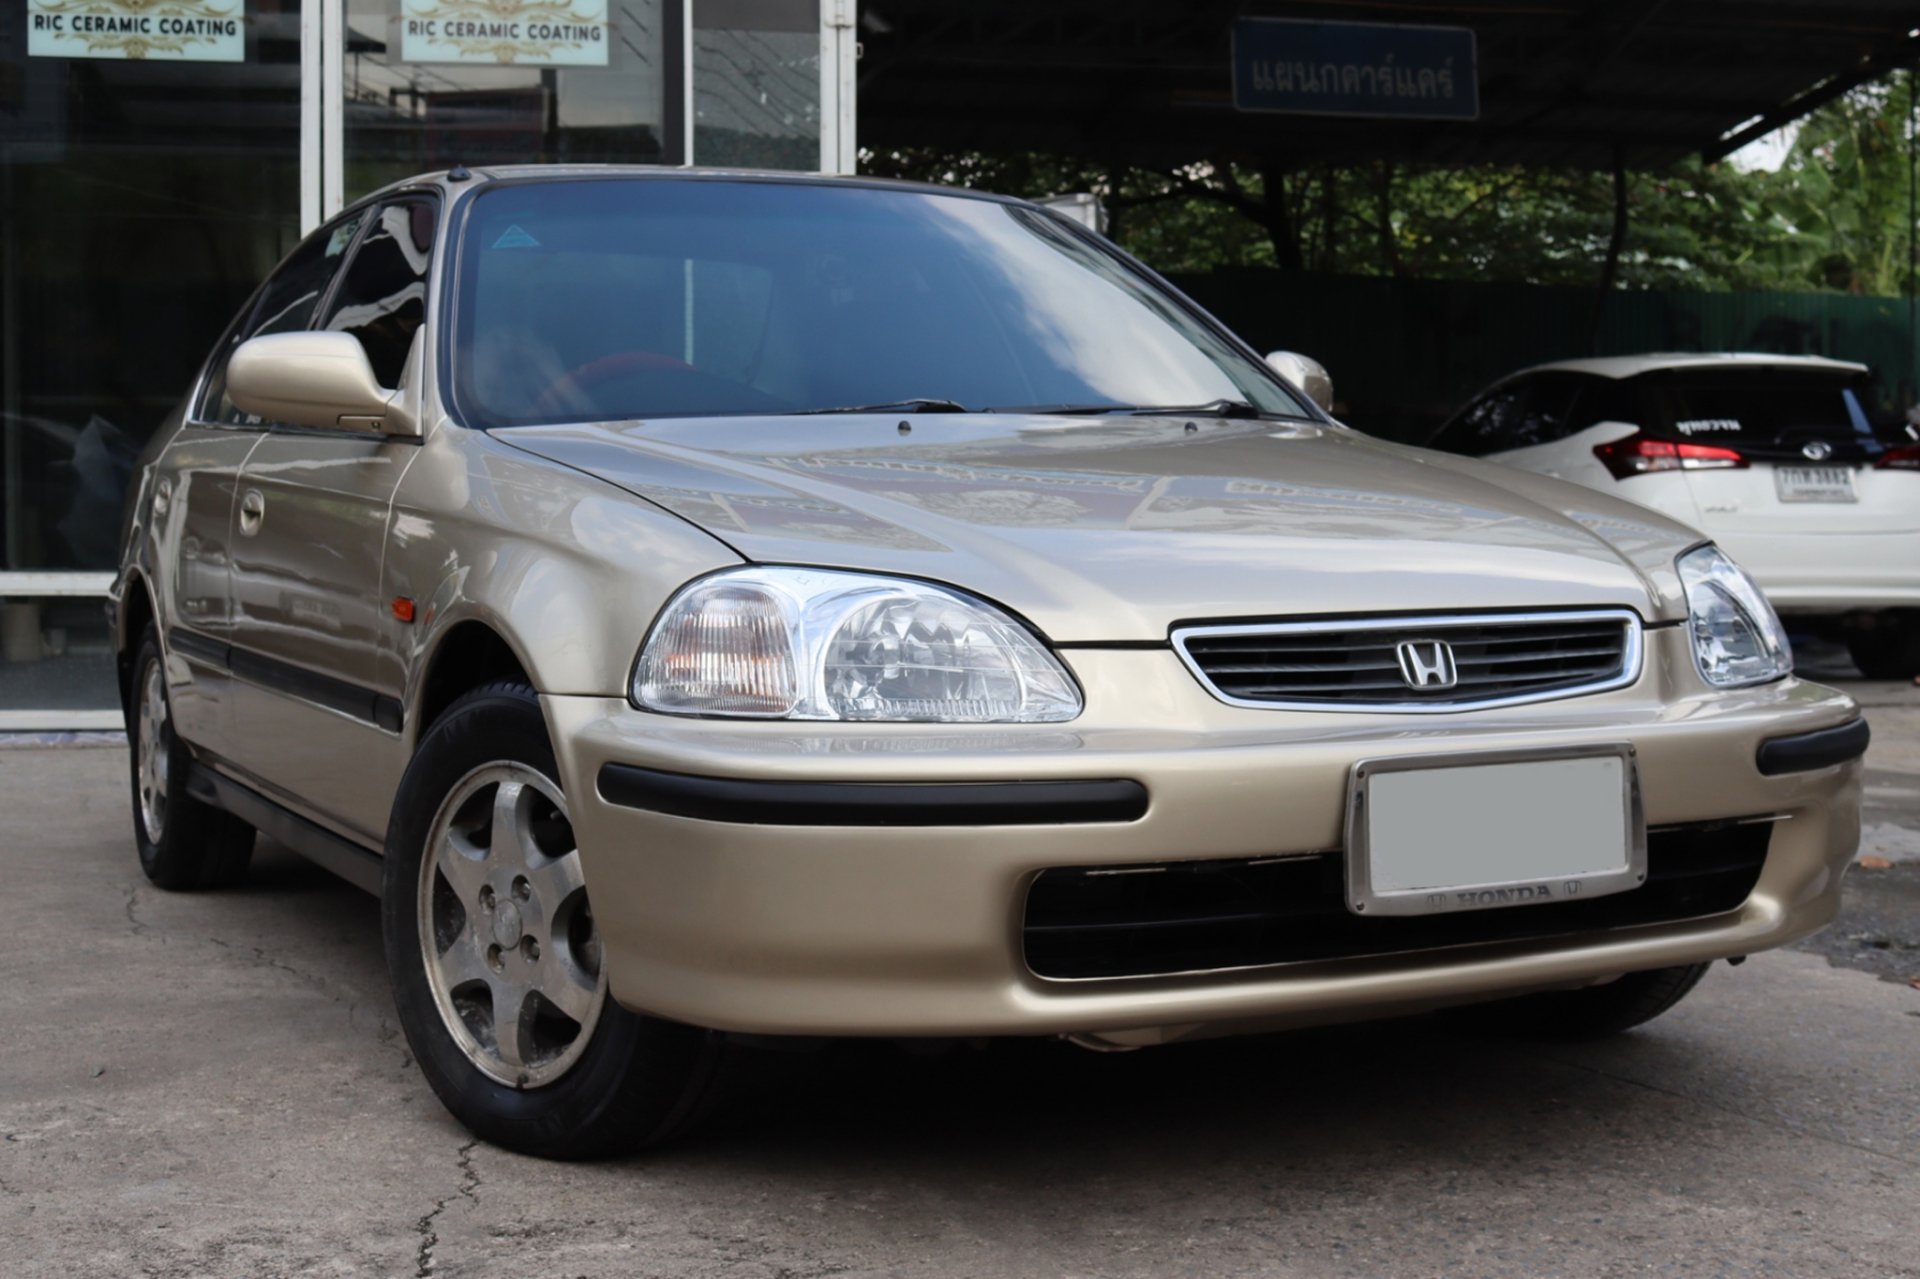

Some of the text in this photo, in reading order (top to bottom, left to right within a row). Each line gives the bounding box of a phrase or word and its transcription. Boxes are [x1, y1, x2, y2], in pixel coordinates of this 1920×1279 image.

[34, 14, 236, 36] RIC CERAMIC COATING
[408, 20, 601, 41] RIC CERAMIC COATING
[1456, 885, 1553, 907] HONDA
